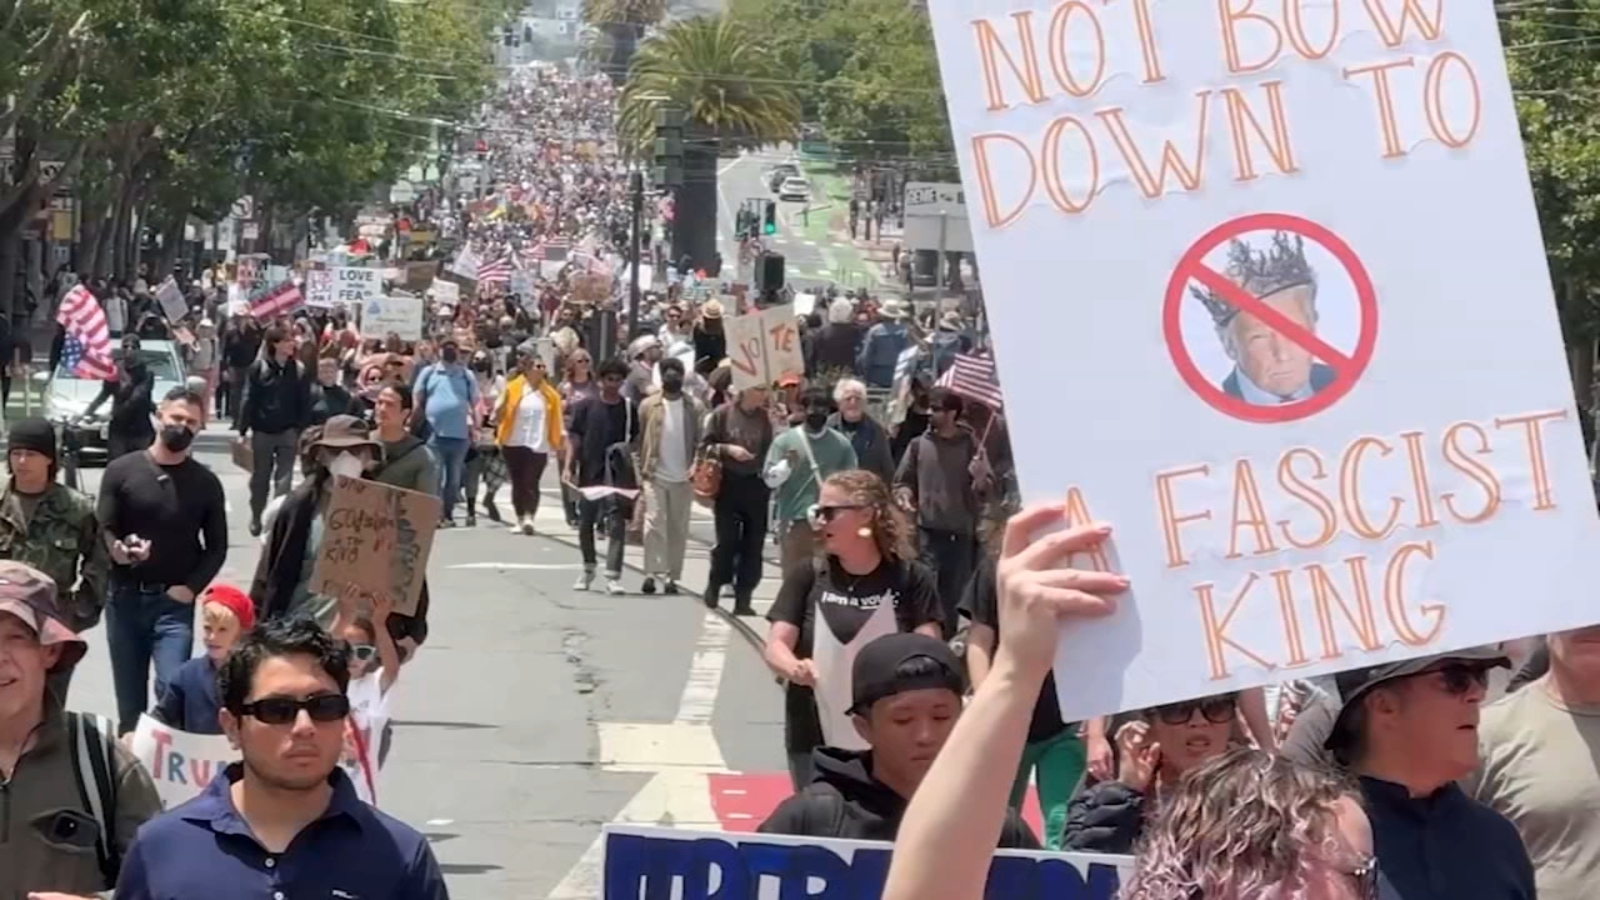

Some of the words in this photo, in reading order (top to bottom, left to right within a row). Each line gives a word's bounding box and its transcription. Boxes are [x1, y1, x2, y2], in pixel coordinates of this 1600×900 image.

[971, 0, 1166, 111] NOT
[971, 80, 1300, 229] DOWN
[1342, 51, 1481, 158] TO
[339, 270, 374, 281] LOVE
[1155, 410, 1568, 569] FASCIST
[1193, 541, 1446, 680] KING
